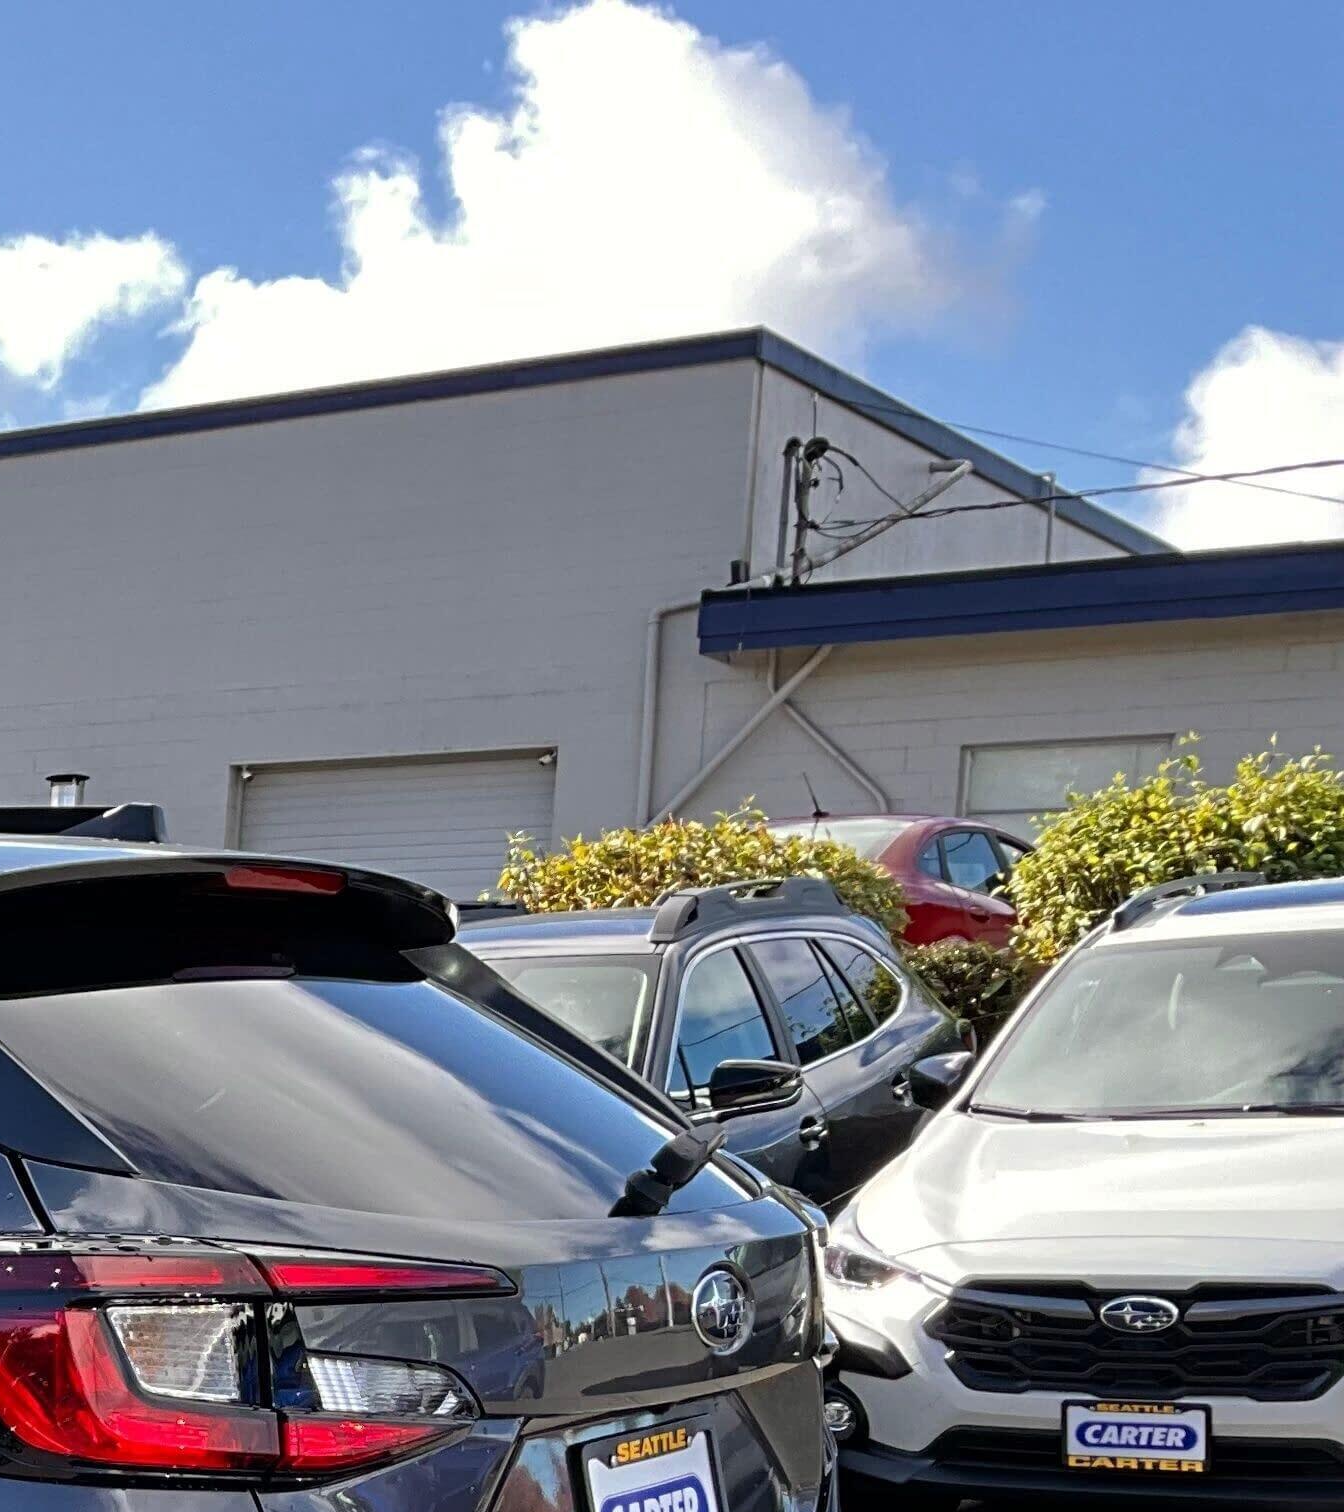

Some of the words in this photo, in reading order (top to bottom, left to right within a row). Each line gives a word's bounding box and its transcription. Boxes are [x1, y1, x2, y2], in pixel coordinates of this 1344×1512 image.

[1096, 1403, 1176, 1414] SEATTLE
[616, 1428, 688, 1464] SEATTLE
[1084, 1424, 1187, 1448] CARTER
[1067, 1455, 1204, 1473] CARTER
